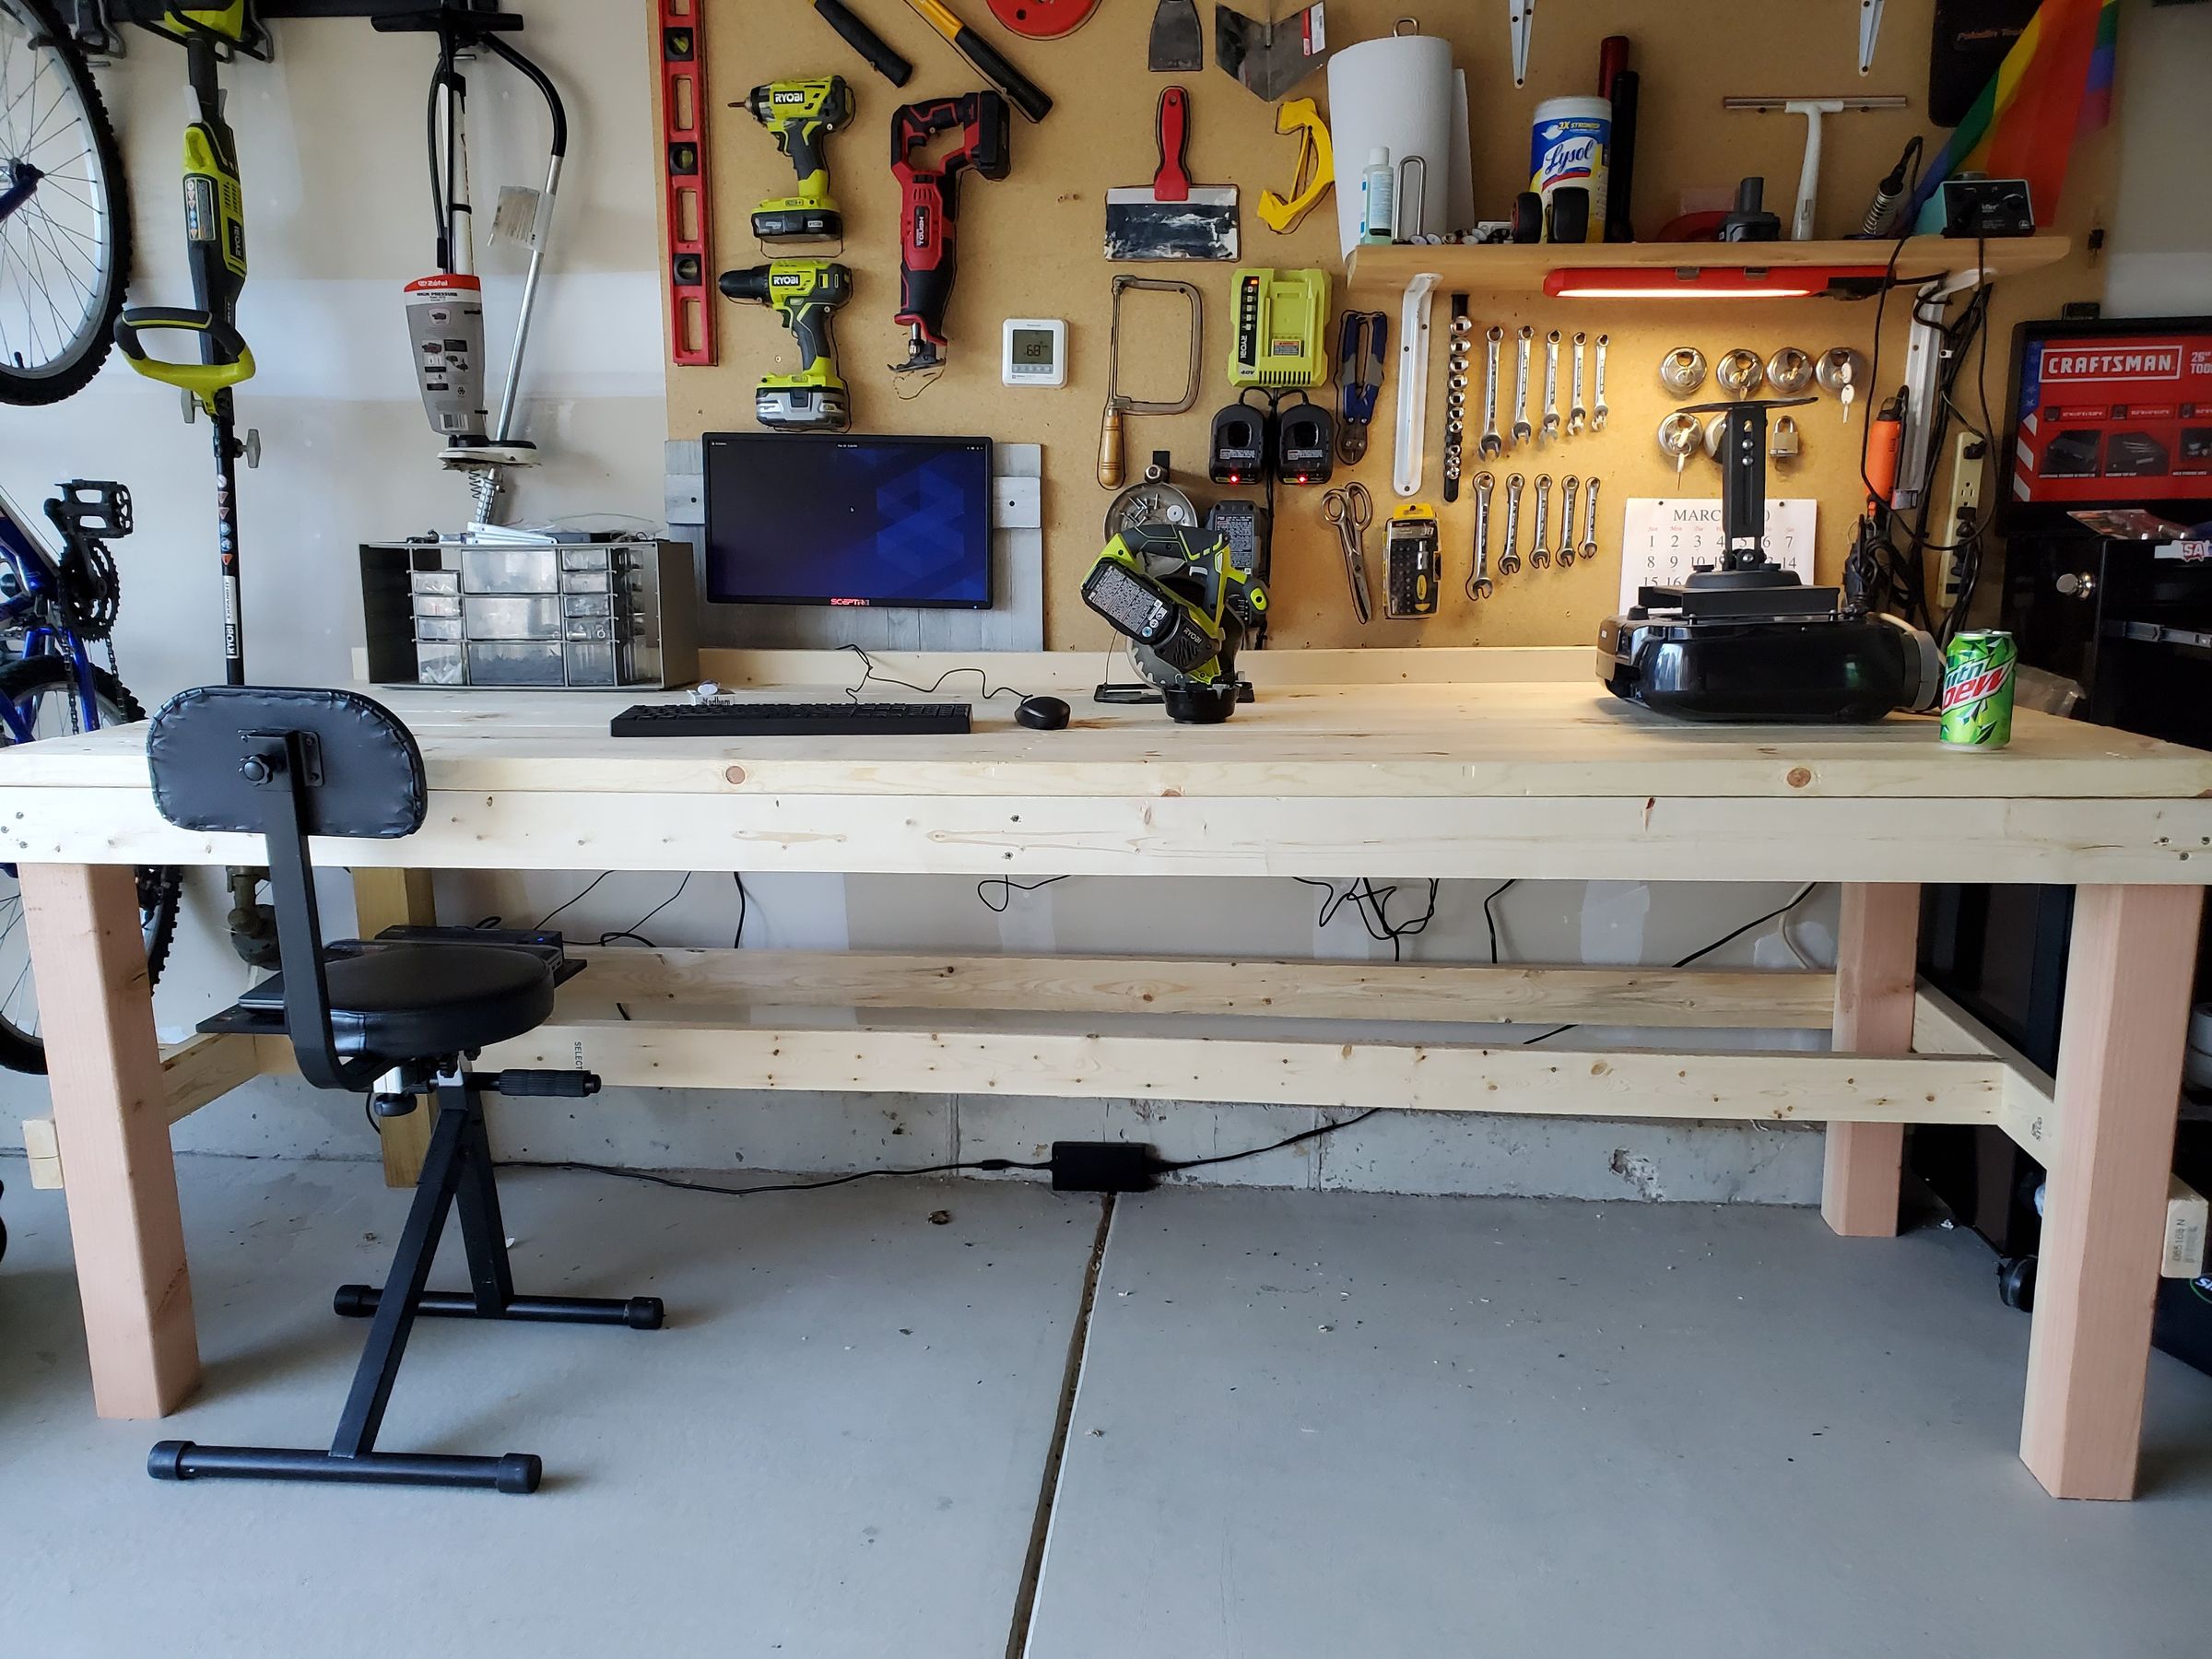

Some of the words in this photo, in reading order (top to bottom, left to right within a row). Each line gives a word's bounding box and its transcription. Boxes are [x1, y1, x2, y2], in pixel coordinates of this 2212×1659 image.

[774, 93, 803, 102] RYOBI
[1545, 139, 1594, 175] Lysol
[233, 225, 243, 258] RYOBI
[773, 276, 799, 285] RYOBI
[1026, 344, 1041, 357] 68
[1240, 335, 1248, 359] RYOBI
[2047, 354, 2171, 374] CRAFTSMAN
[1673, 509, 1723, 522] MARC
[1649, 535, 1654, 547] 1
[1670, 535, 1680, 547] 2
[1693, 535, 1702, 547] 3
[1716, 535, 1725, 547] 4
[1739, 536, 1747, 548] 5
[1762, 535, 1771, 548] 6
[1785, 535, 1794, 548] 7
[1647, 556, 1655, 569] 8
[1669, 556, 1678, 569] 9
[1783, 557, 1797, 569] 14
[226, 625, 236, 655] RYOBI
[1182, 627, 1204, 644] RYOBI
